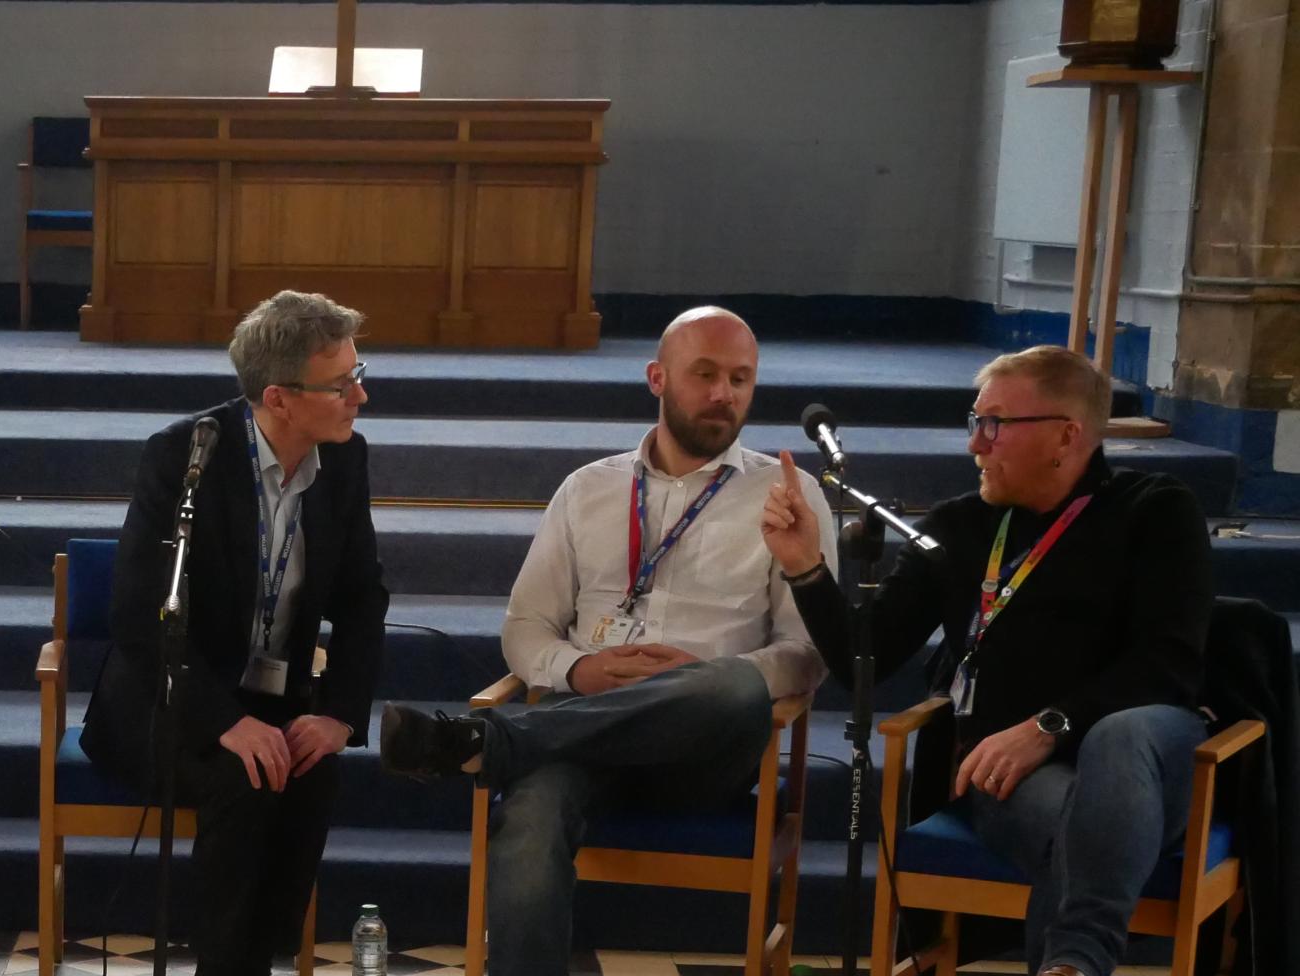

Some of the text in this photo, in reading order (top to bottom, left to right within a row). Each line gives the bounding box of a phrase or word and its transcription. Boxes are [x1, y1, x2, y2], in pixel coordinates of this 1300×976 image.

[245, 419, 254, 444] VISITOR
[695, 491, 713, 509] VISITOR
[672, 518, 689, 537] VISITOR
[282, 534, 293, 558] VISITOR
[650, 546, 666, 565] VISITOR
[273, 571, 283, 594] VISITOR
